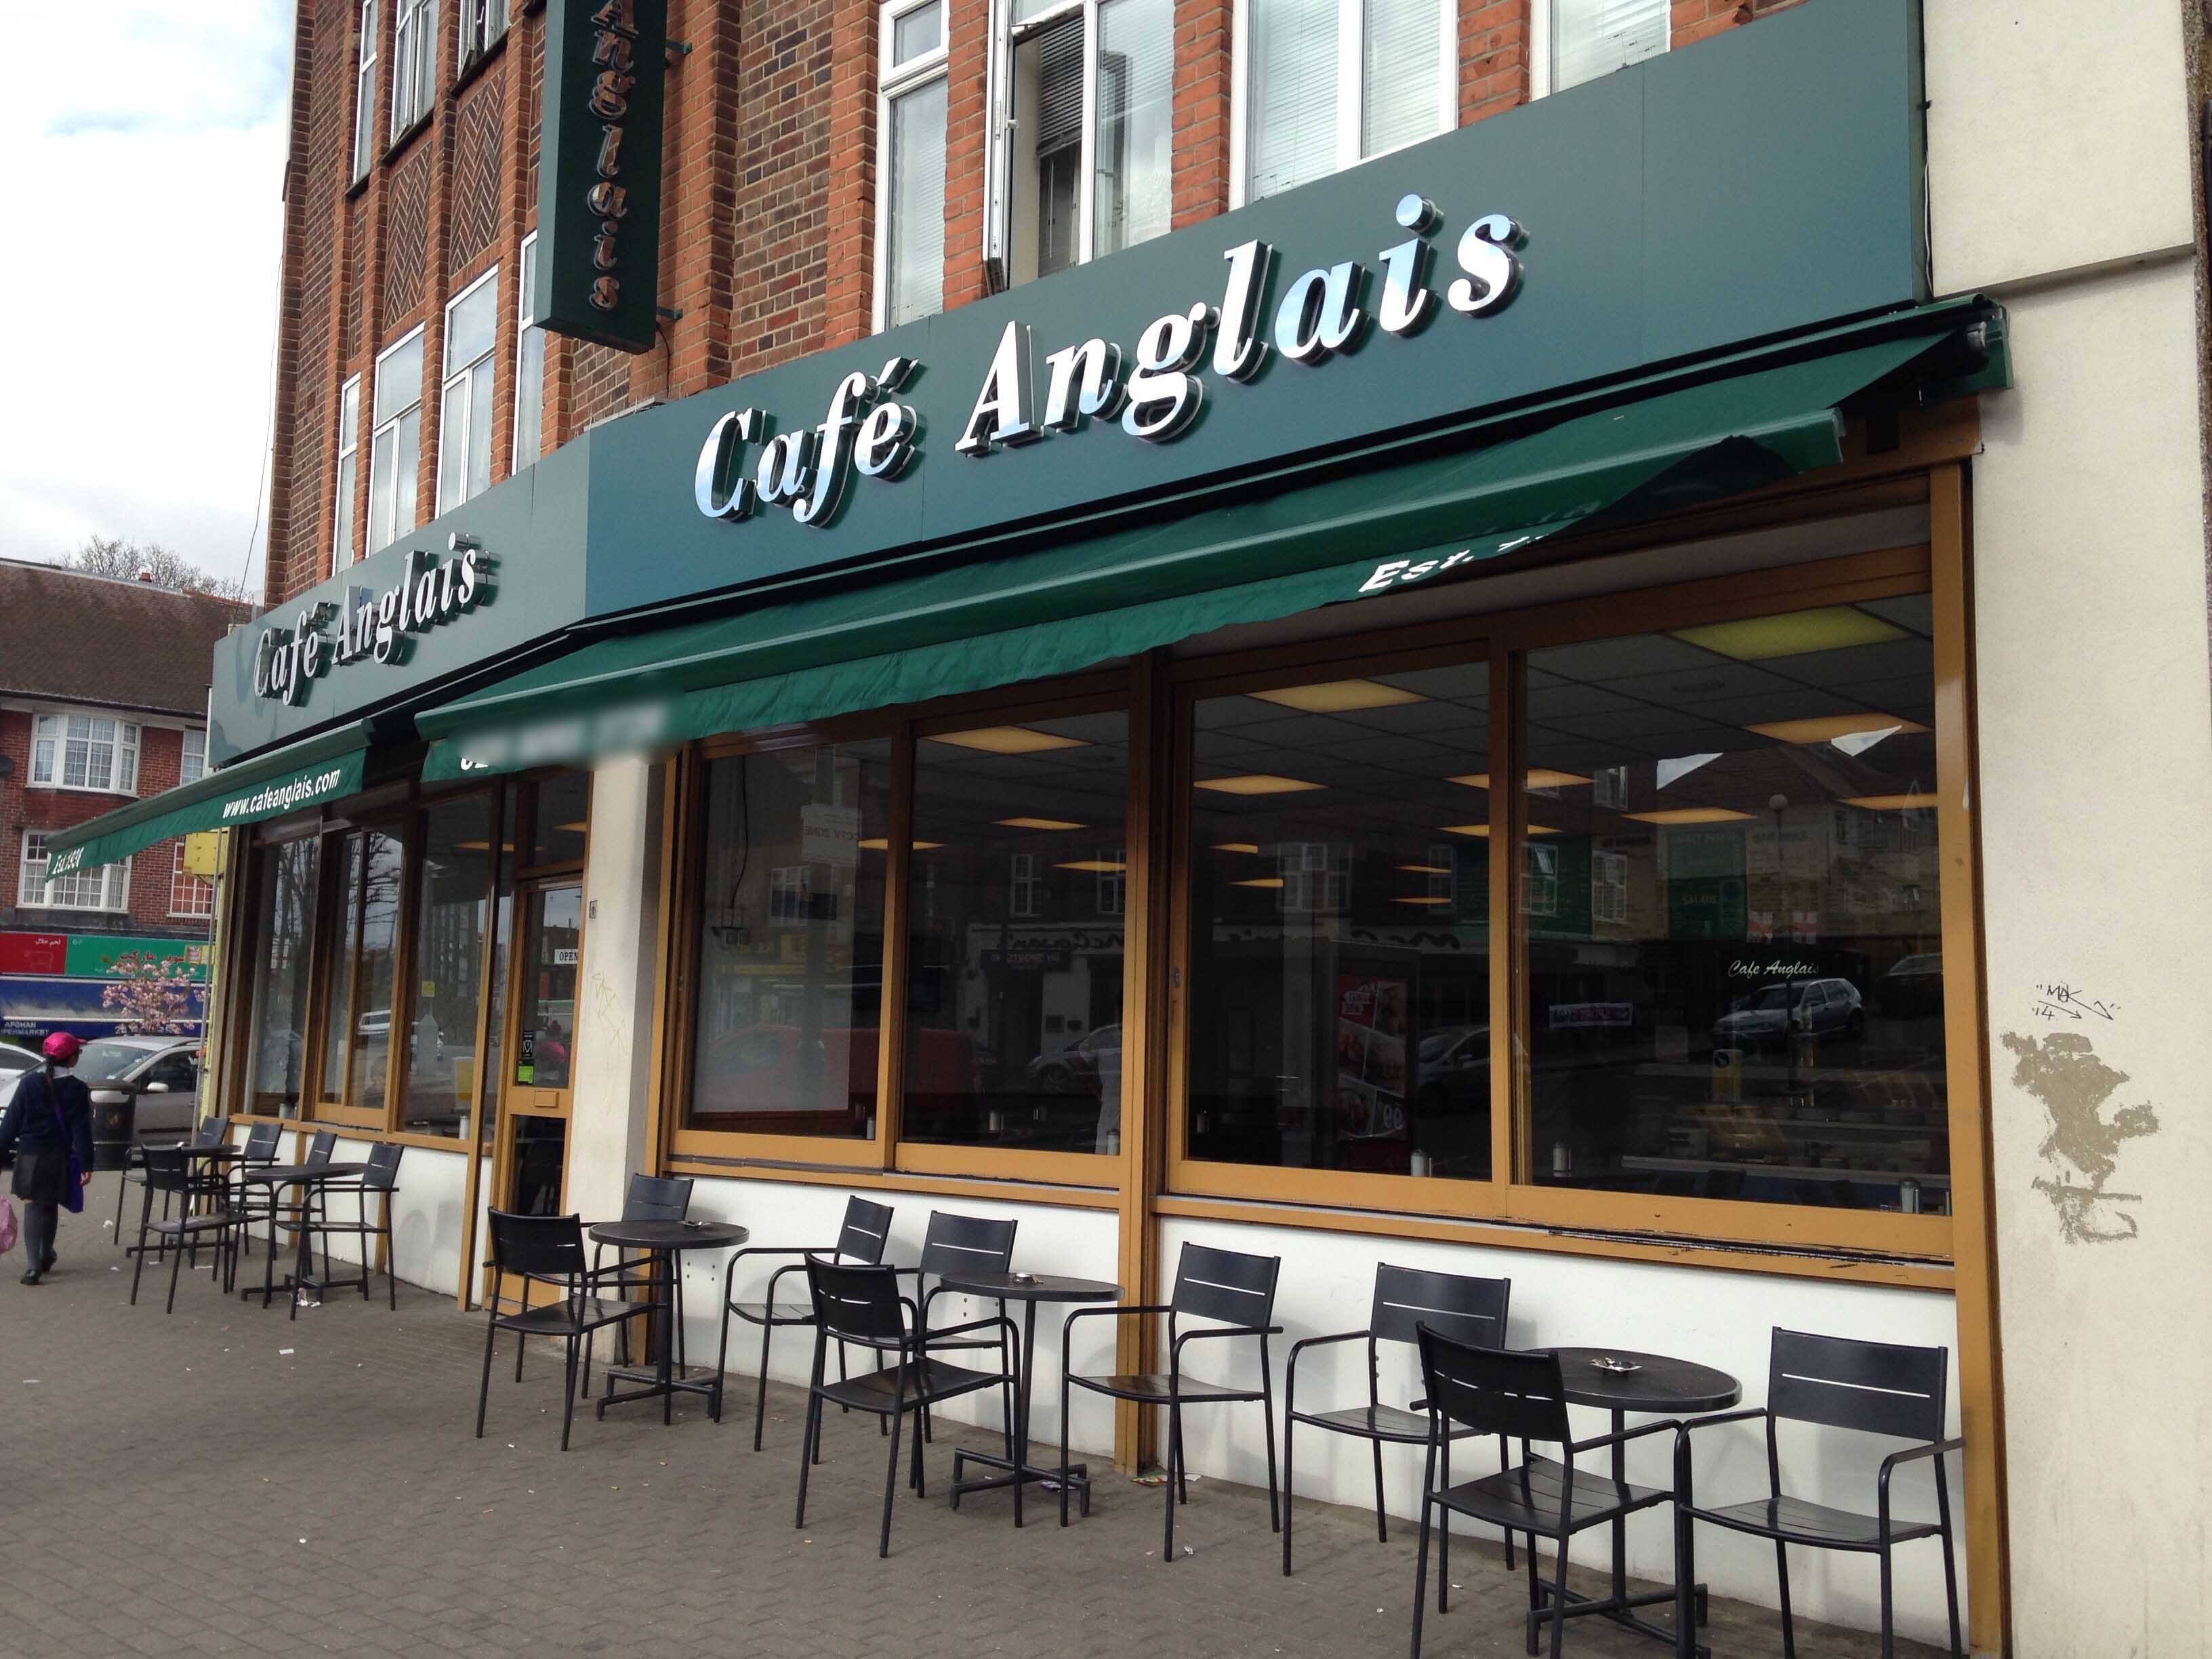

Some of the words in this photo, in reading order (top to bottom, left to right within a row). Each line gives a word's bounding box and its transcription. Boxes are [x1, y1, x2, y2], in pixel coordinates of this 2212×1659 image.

[587, 0, 639, 312] Anglais
[695, 356, 914, 527] Café
[956, 194, 1519, 450] Anglais
[253, 600, 325, 707] Café
[332, 531, 481, 665] Anglais
[222, 769, 341, 819] www.cafeanglais.com
[1728, 960, 1761, 979] Cafe
